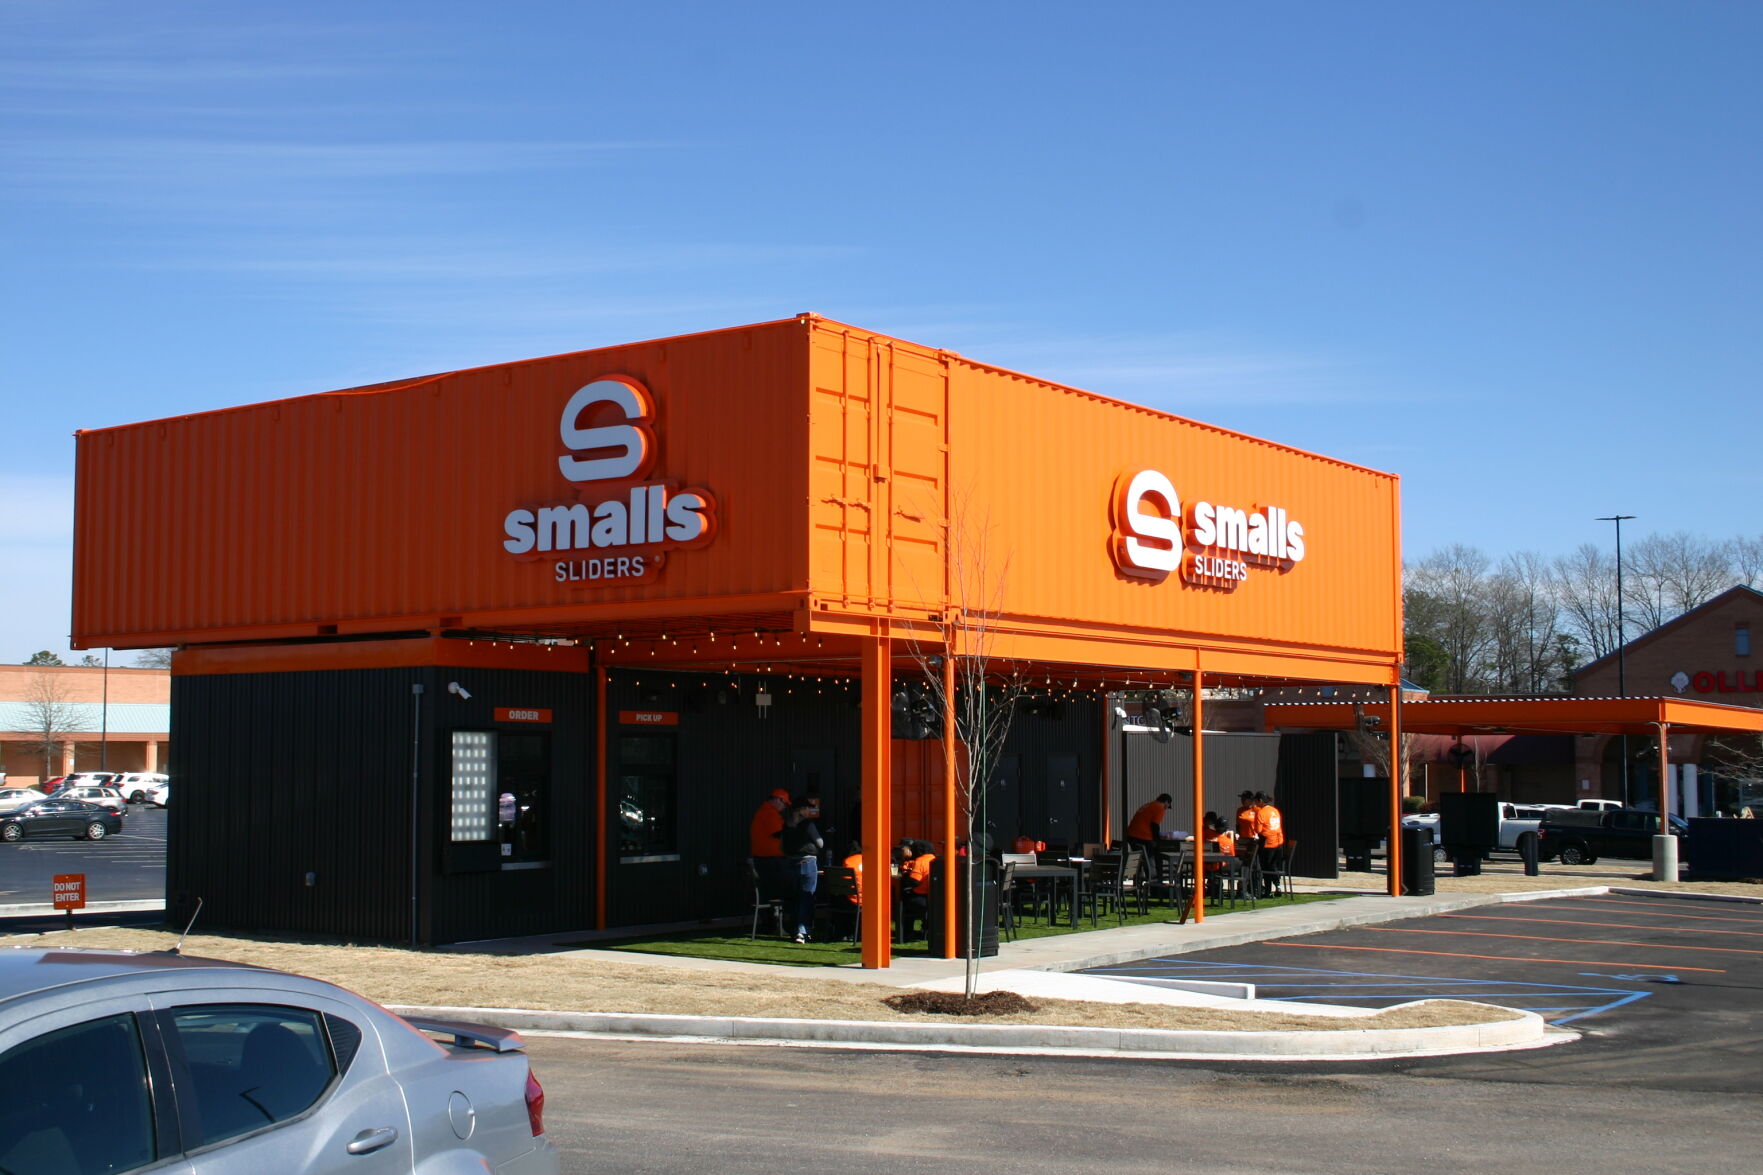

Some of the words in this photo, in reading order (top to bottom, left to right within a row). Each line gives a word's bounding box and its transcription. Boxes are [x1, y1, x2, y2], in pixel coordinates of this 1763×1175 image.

[558, 379, 647, 482] S
[503, 484, 707, 555] smalls
[1126, 469, 1183, 572] S
[1194, 501, 1305, 562] smalls
[555, 556, 645, 583] SLIDERS
[1194, 555, 1248, 582] SLIDERS
[508, 710, 539, 721] ORDER
[635, 713, 652, 722] PICK
[653, 714, 663, 722] UP
[54, 882, 65, 892] DO
[65, 881, 81, 891] NOT
[55, 892, 80, 902] ENTER
